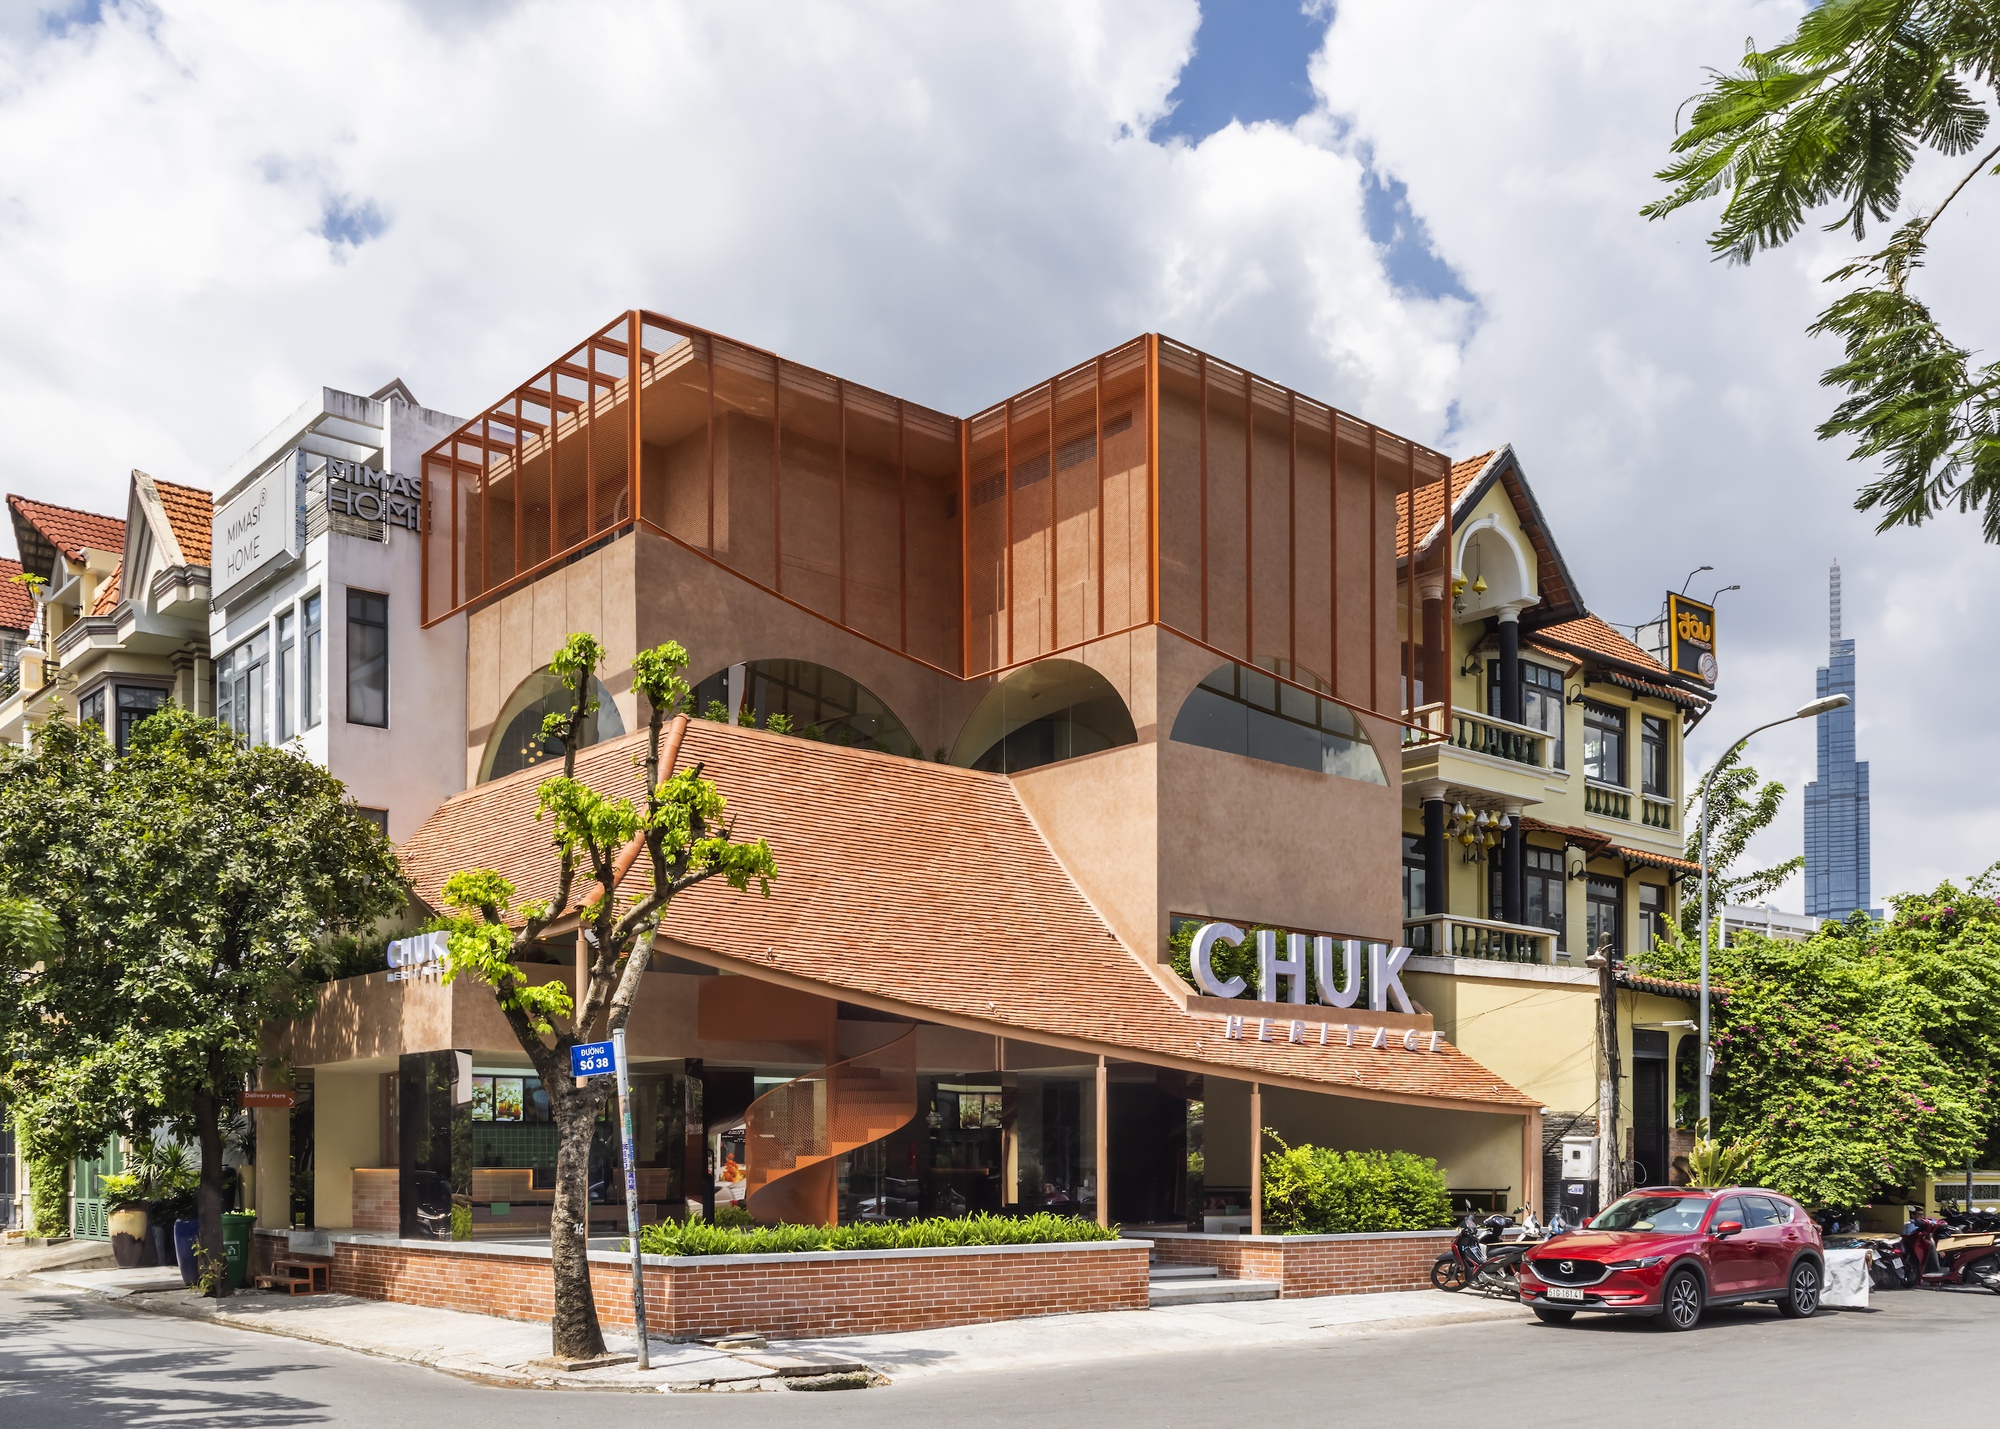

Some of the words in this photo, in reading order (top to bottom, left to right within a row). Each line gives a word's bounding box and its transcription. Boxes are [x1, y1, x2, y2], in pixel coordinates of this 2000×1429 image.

[227, 535, 260, 578] HOME
[387, 930, 452, 968] CHUK
[1190, 922, 1416, 1014] CHUK
[580, 1046, 605, 1056] ĐƯỜNG
[1225, 1015, 1446, 1052] HERITAGE
[580, 1056, 594, 1070] SỐ
[596, 1057, 609, 1068] 38
